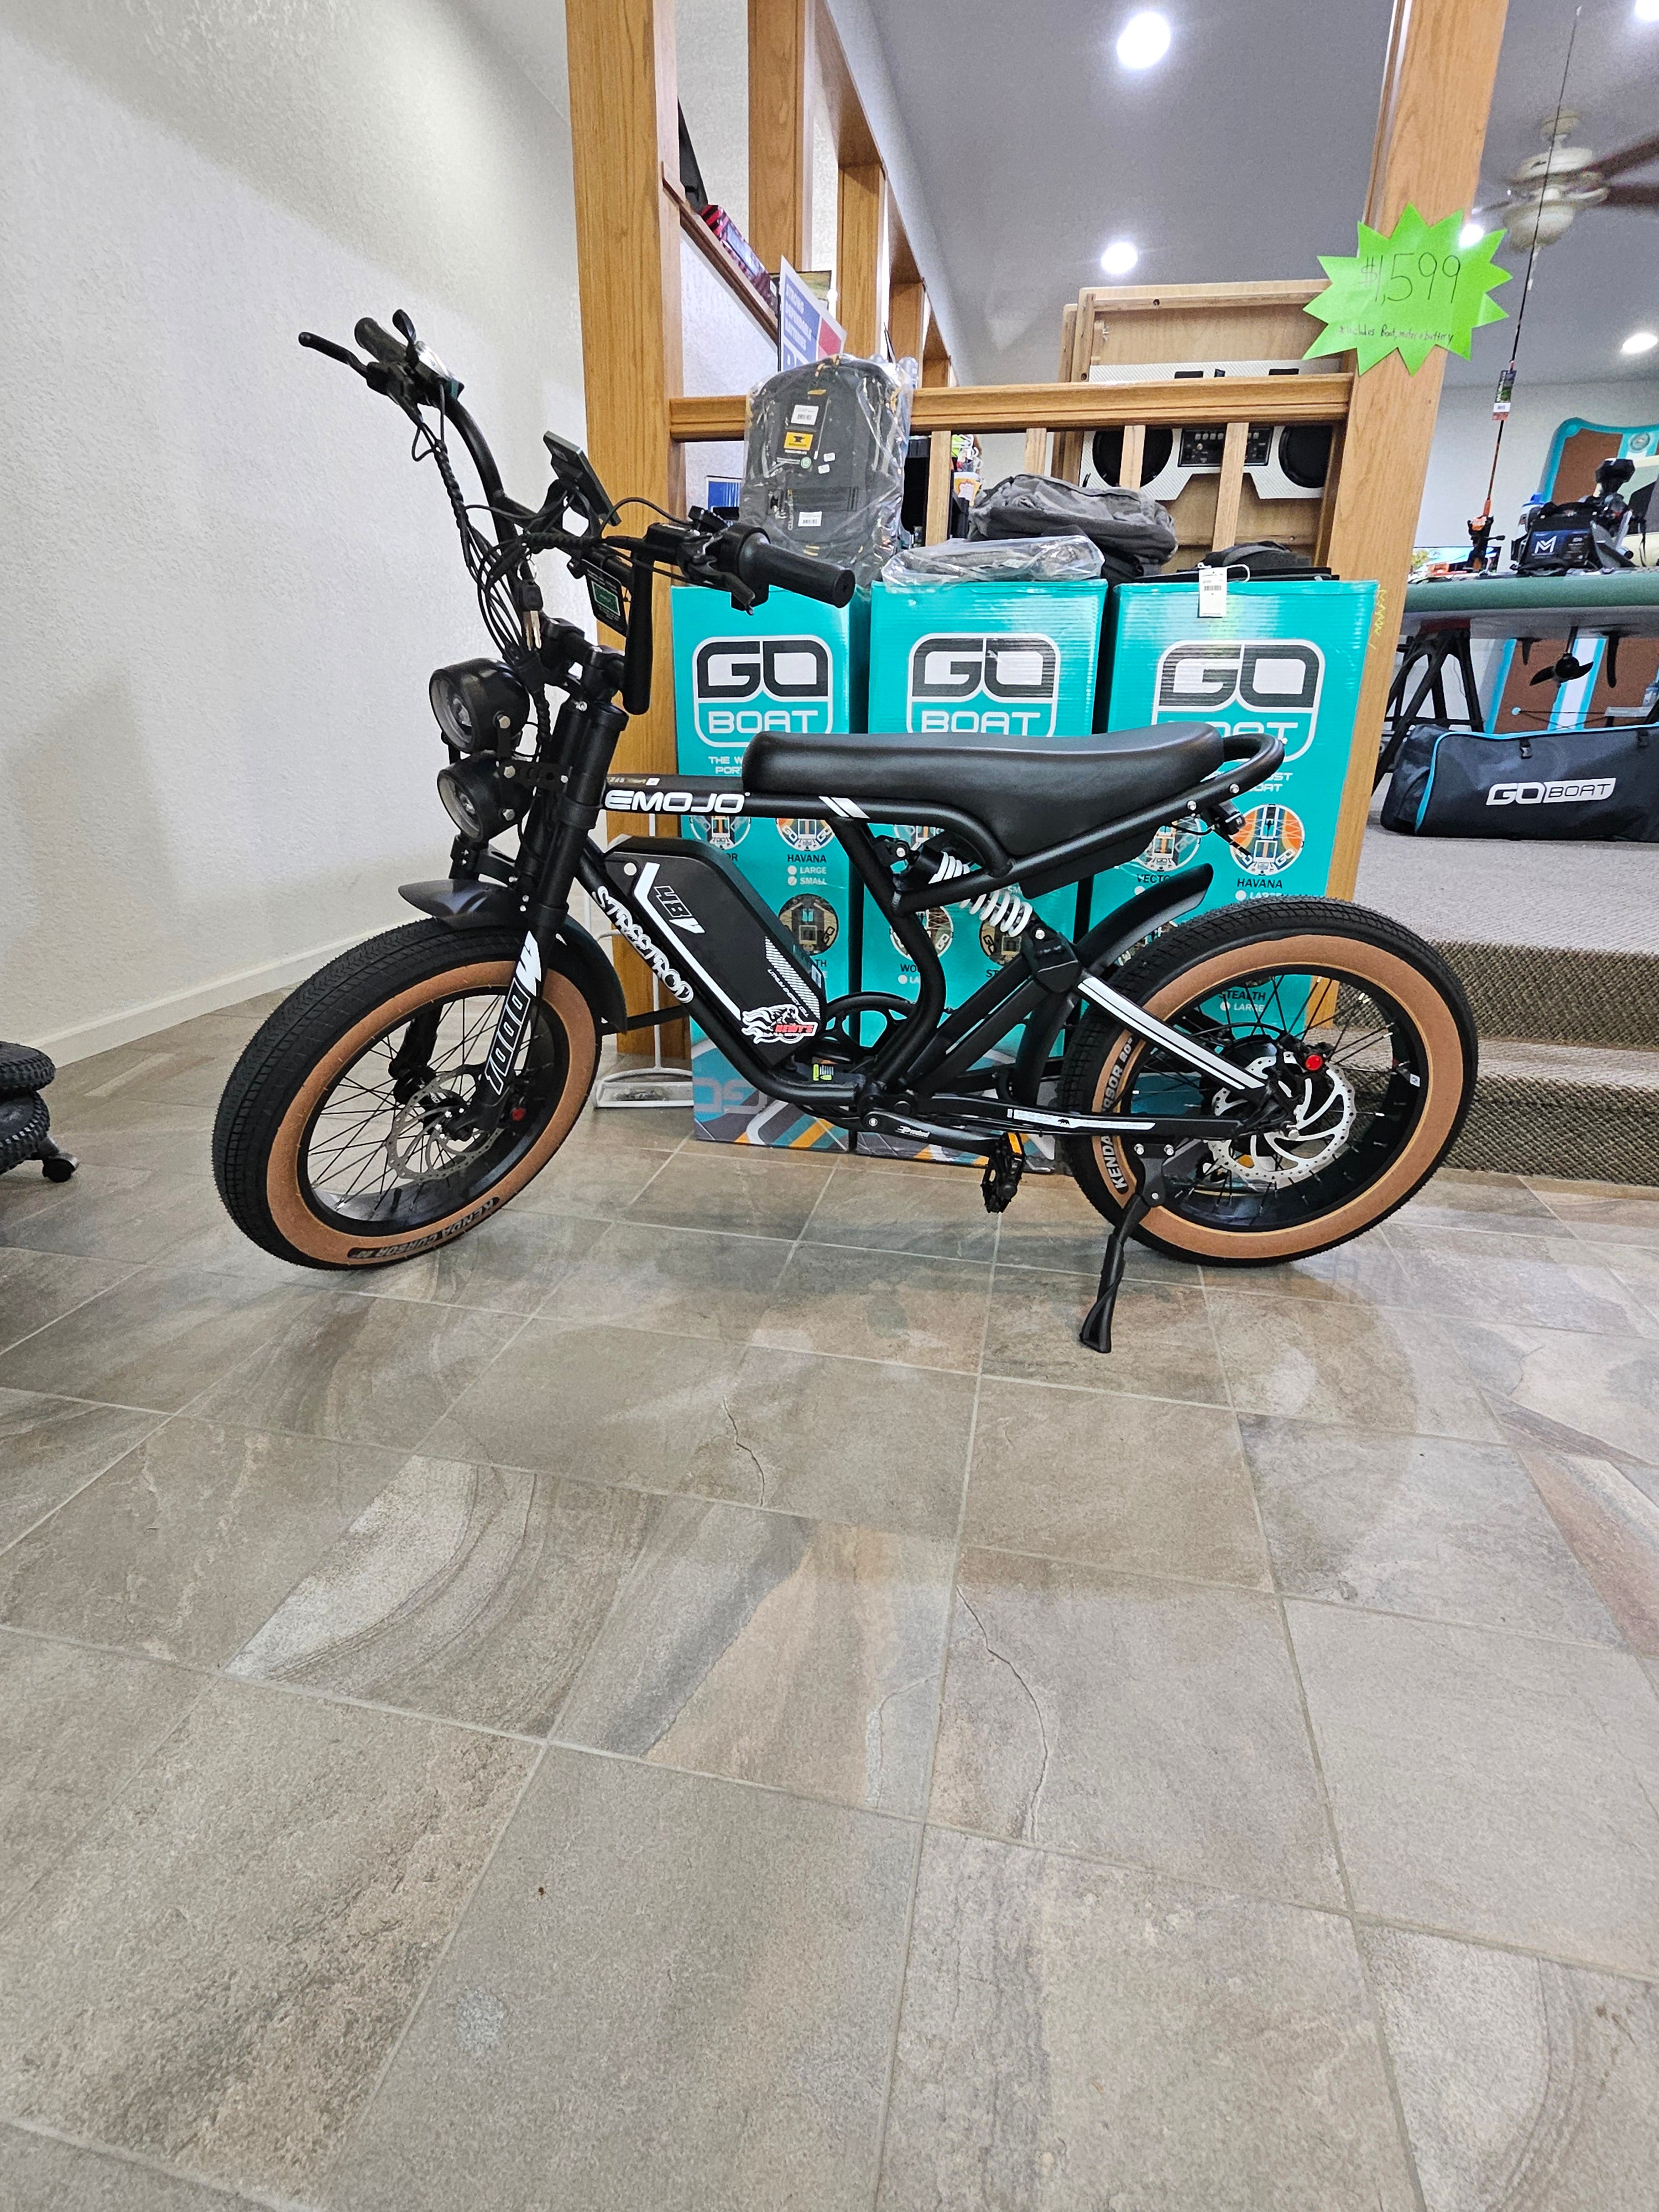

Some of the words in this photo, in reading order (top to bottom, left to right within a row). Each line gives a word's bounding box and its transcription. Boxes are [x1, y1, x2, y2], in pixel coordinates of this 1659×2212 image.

[1358, 252, 1461, 305] $1,599
[696, 639, 829, 698] GO
[912, 638, 1056, 698] GO
[1159, 643, 1319, 708] GO
[708, 710, 818, 734] BOAT
[921, 710, 1041, 736] BOAT
[708, 756, 731, 764] THE
[604, 790, 745, 814] EMOJO
[1485, 781, 1546, 806] GO
[1548, 783, 1612, 799] BOAT
[786, 854, 827, 863] HAVANA
[800, 866, 827, 874] LARGE
[1237, 878, 1283, 889] HAVANA
[1101, 1135, 1128, 1189] KENDA
[375, 1233, 437, 1257] CURSOR
